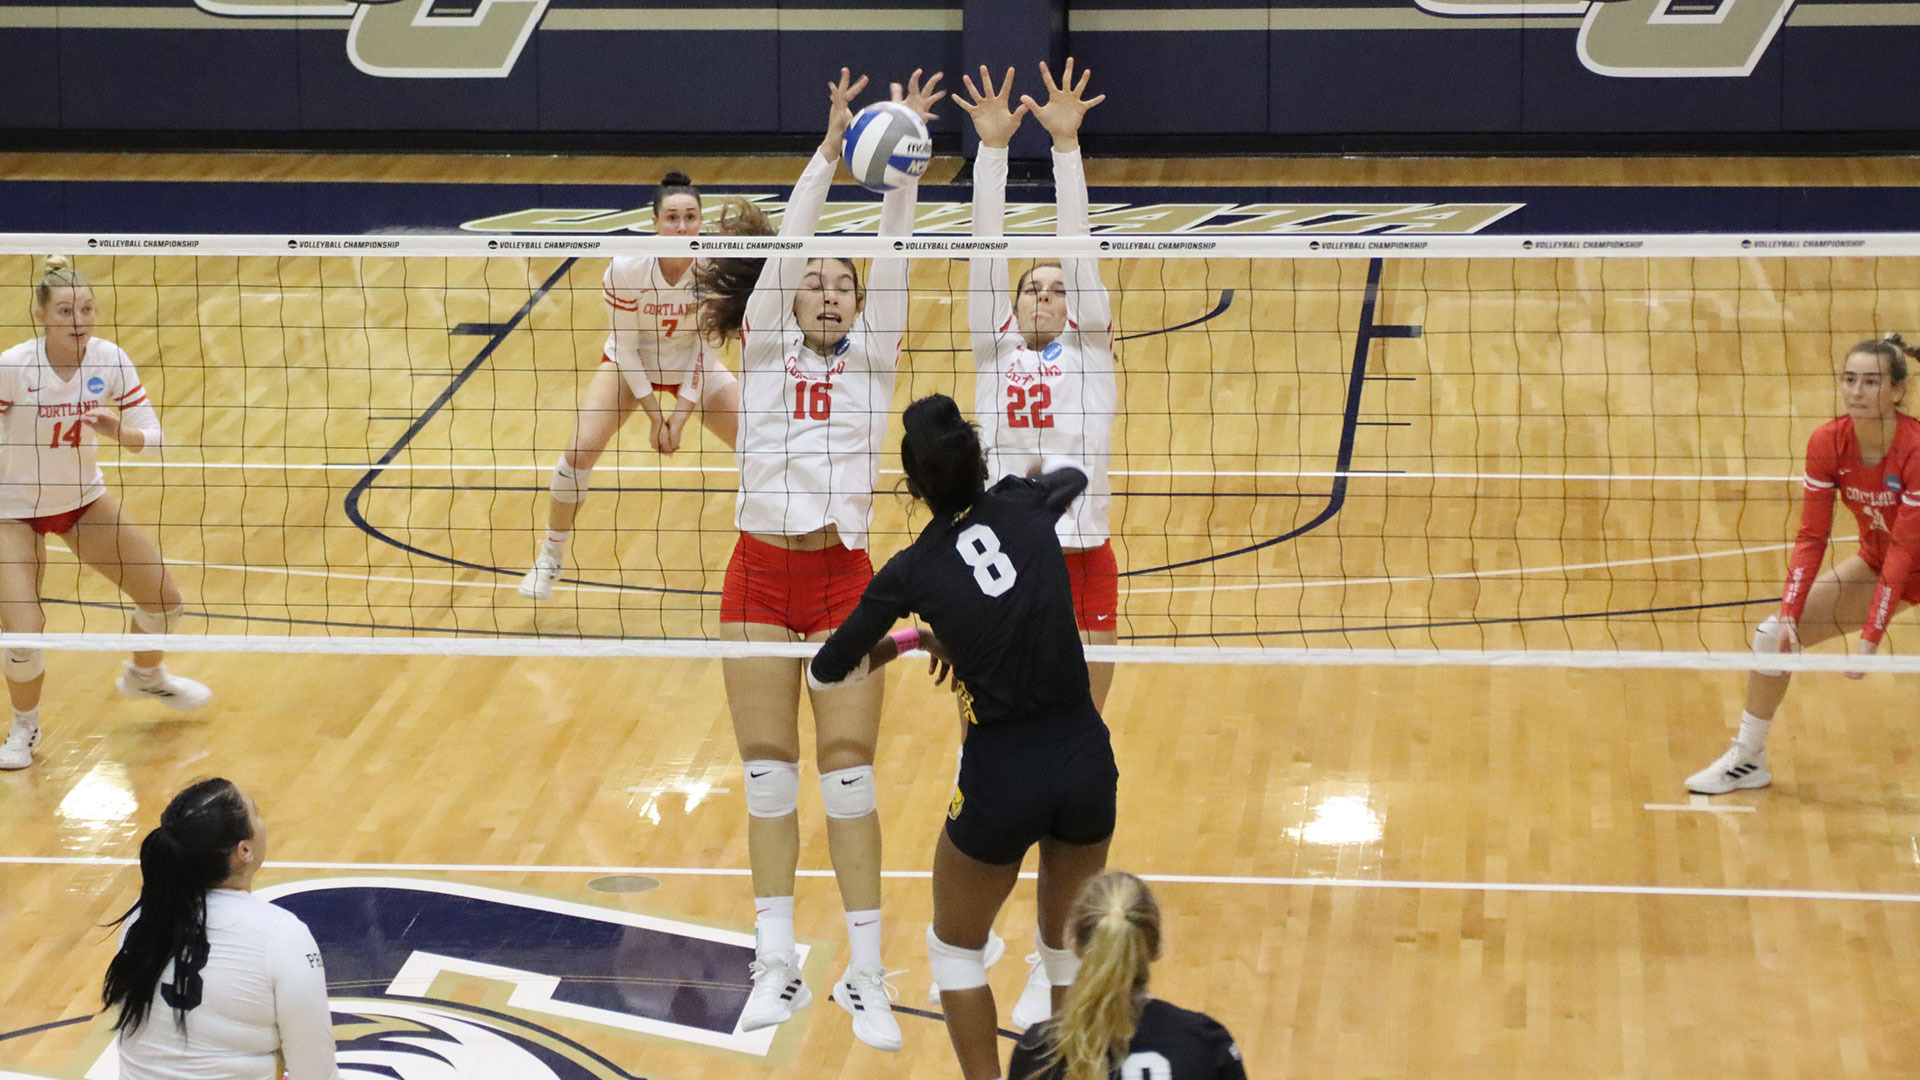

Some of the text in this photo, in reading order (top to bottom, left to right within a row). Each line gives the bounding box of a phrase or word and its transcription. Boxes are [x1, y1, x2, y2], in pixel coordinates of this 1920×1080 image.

[300, 240, 400, 248] VOLLEYBALL CHAMPIONSHIP
[500, 241, 601, 249] VOLLEYBALL CHAMPIONSHIP
[702, 241, 804, 249] VOLLEYBALL CHAMPIONSHIP
[906, 242, 1009, 250] VOLLEYBALL CHAMPIONSHIP
[1112, 242, 1216, 250] VOLLEYBALL CHAMPIONSHIP
[1322, 241, 1428, 250] VOLLEYBALL CHAMPIONSHIP
[1535, 241, 1644, 249] VOLLEYBALL CHAMPIONSHIP
[1753, 240, 1866, 248] VOLLEYBALL CHAMPIONSHIP
[643, 303, 697, 316] CORTLA
[661, 319, 678, 338] 7
[793, 380, 833, 420] 16
[1007, 384, 1054, 428] 22
[50, 420, 83, 449] 14
[955, 523, 1017, 598] 8
